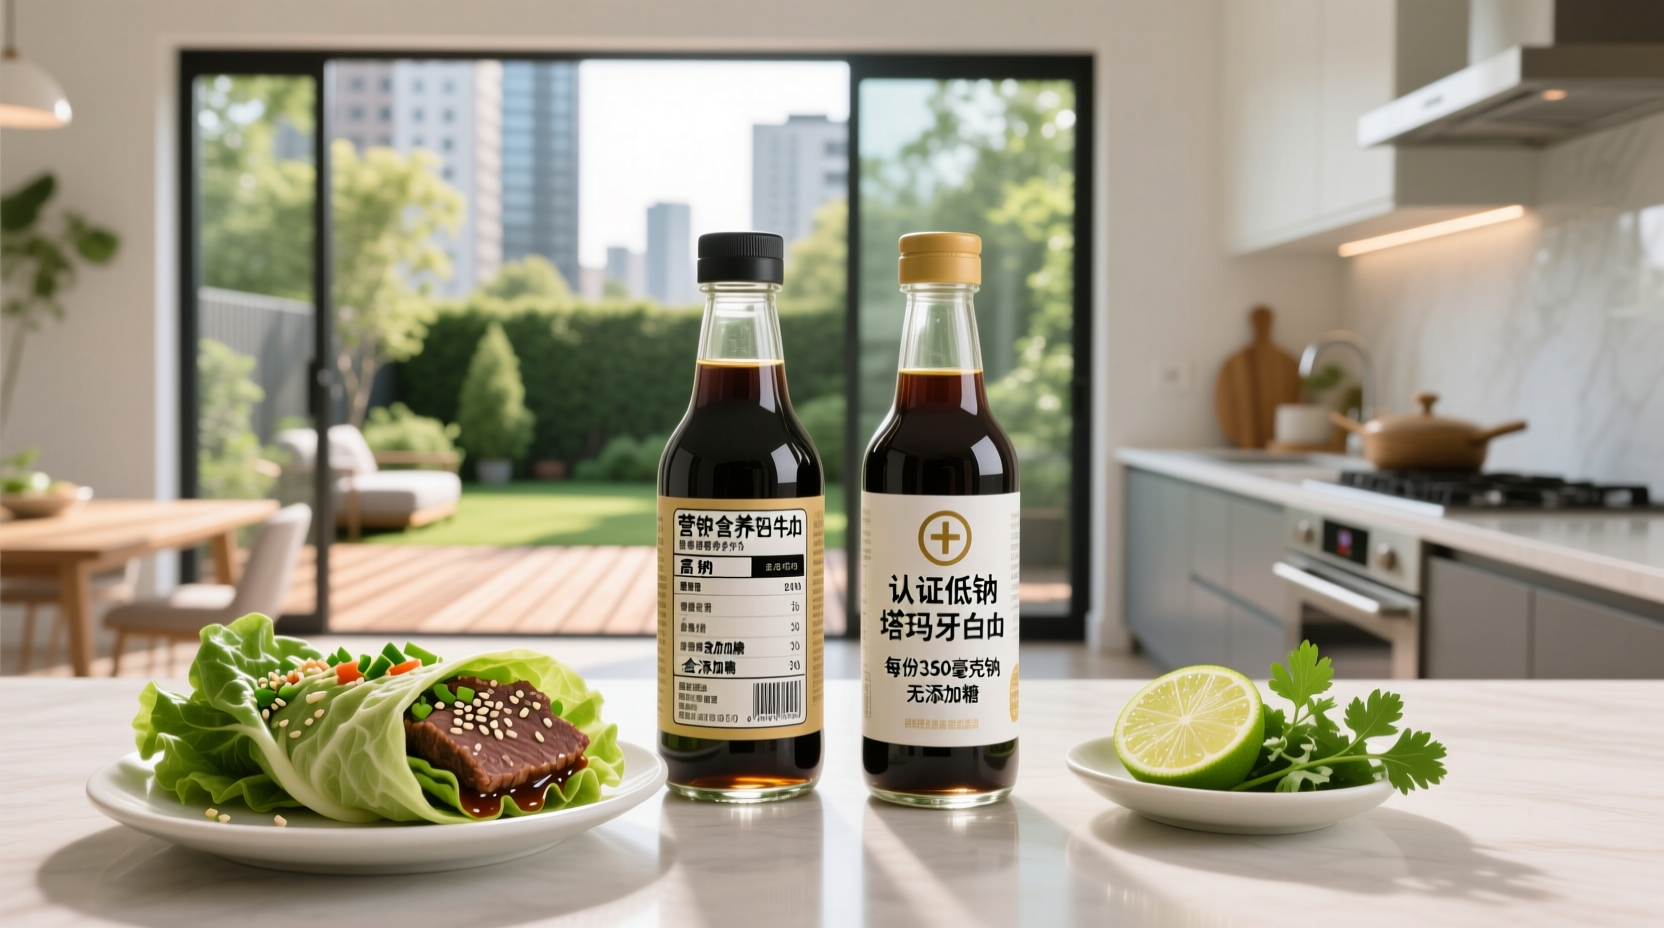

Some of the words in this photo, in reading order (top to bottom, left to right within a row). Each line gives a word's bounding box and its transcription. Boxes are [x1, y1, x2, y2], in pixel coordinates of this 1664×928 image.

[888, 574, 998, 605] 认证低钠
[885, 656, 1001, 679] 每份350毫克钠
[907, 684, 980, 704] 无添加糖
